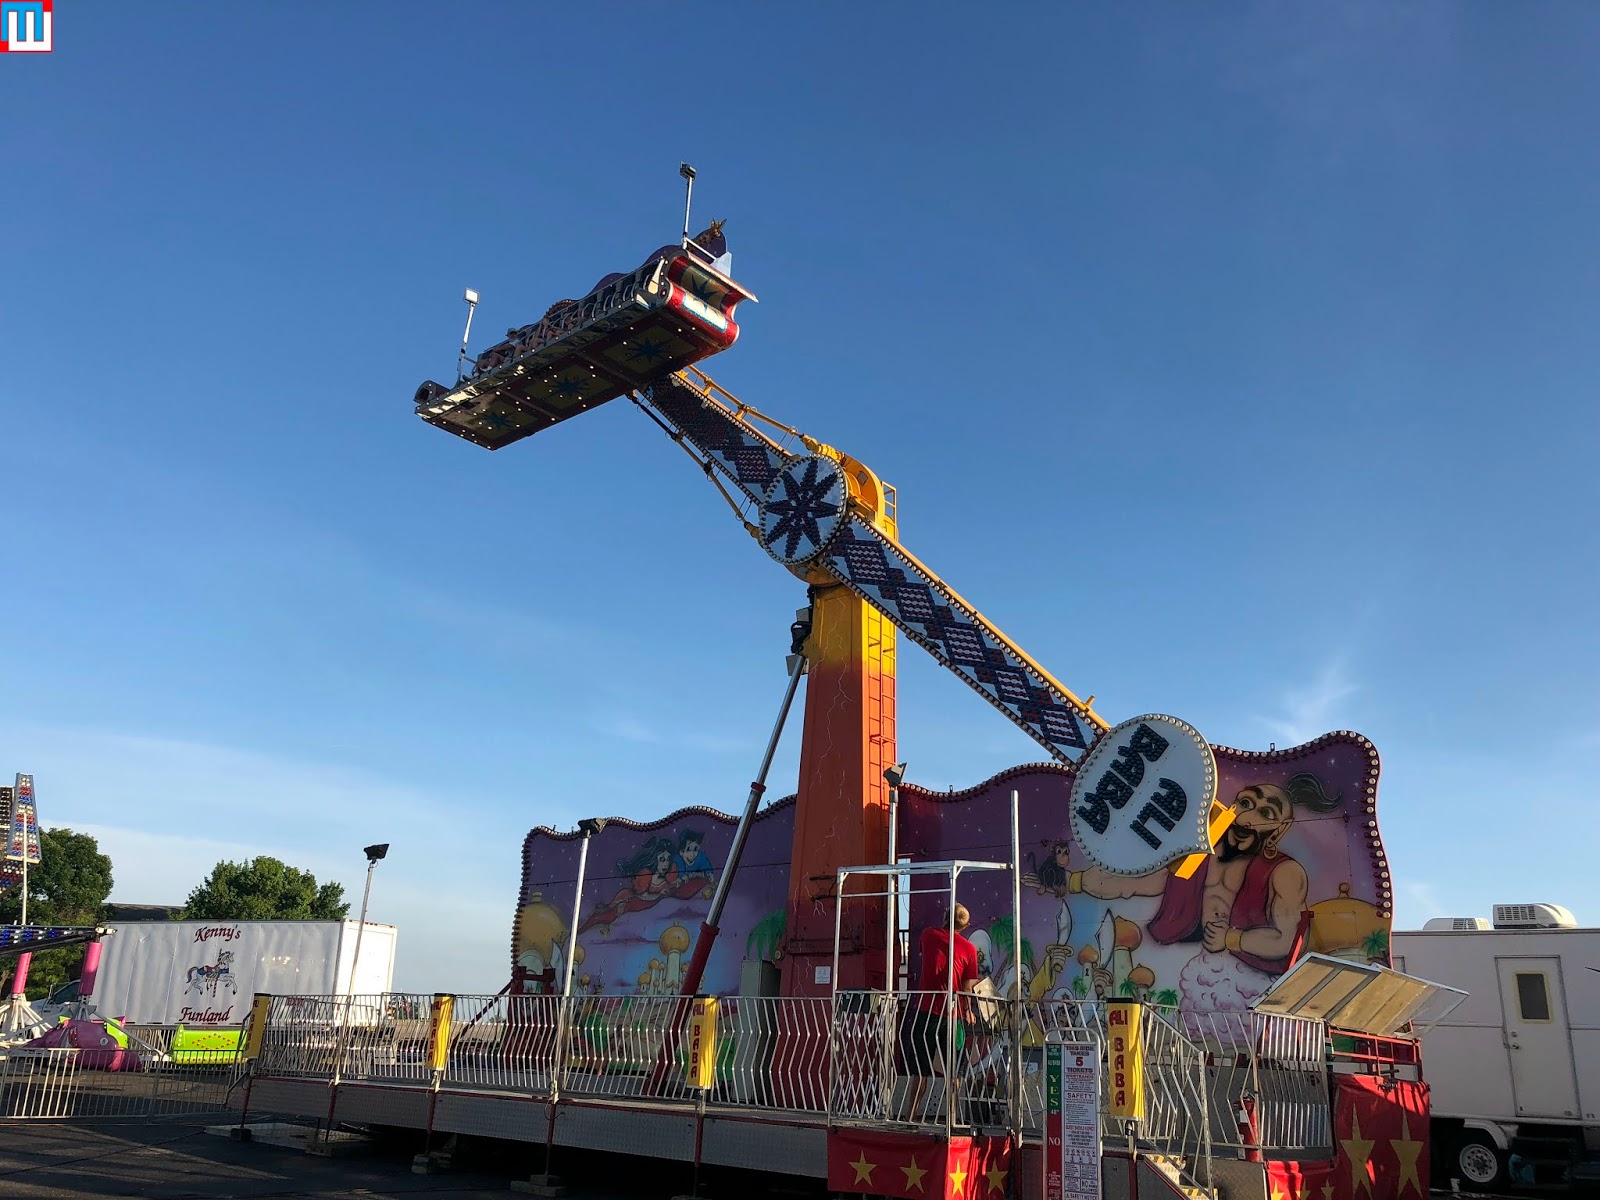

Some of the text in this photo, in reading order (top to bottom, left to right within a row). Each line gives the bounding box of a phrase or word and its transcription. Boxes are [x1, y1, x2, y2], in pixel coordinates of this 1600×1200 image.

[1076, 723, 1170, 835] BABA
[1130, 777, 1187, 851] ALI
[194, 924, 241, 943] Kenny's
[179, 1006, 233, 1022] Funland
[692, 1003, 705, 1017] ALI
[1109, 1009, 1129, 1027] ALI
[690, 1024, 701, 1079] BABA
[1076, 1057, 1083, 1066] 5
[1113, 1037, 1126, 1108] BABA
[1050, 1074, 1060, 1106] YES
[1049, 1137, 1060, 1145] NO
